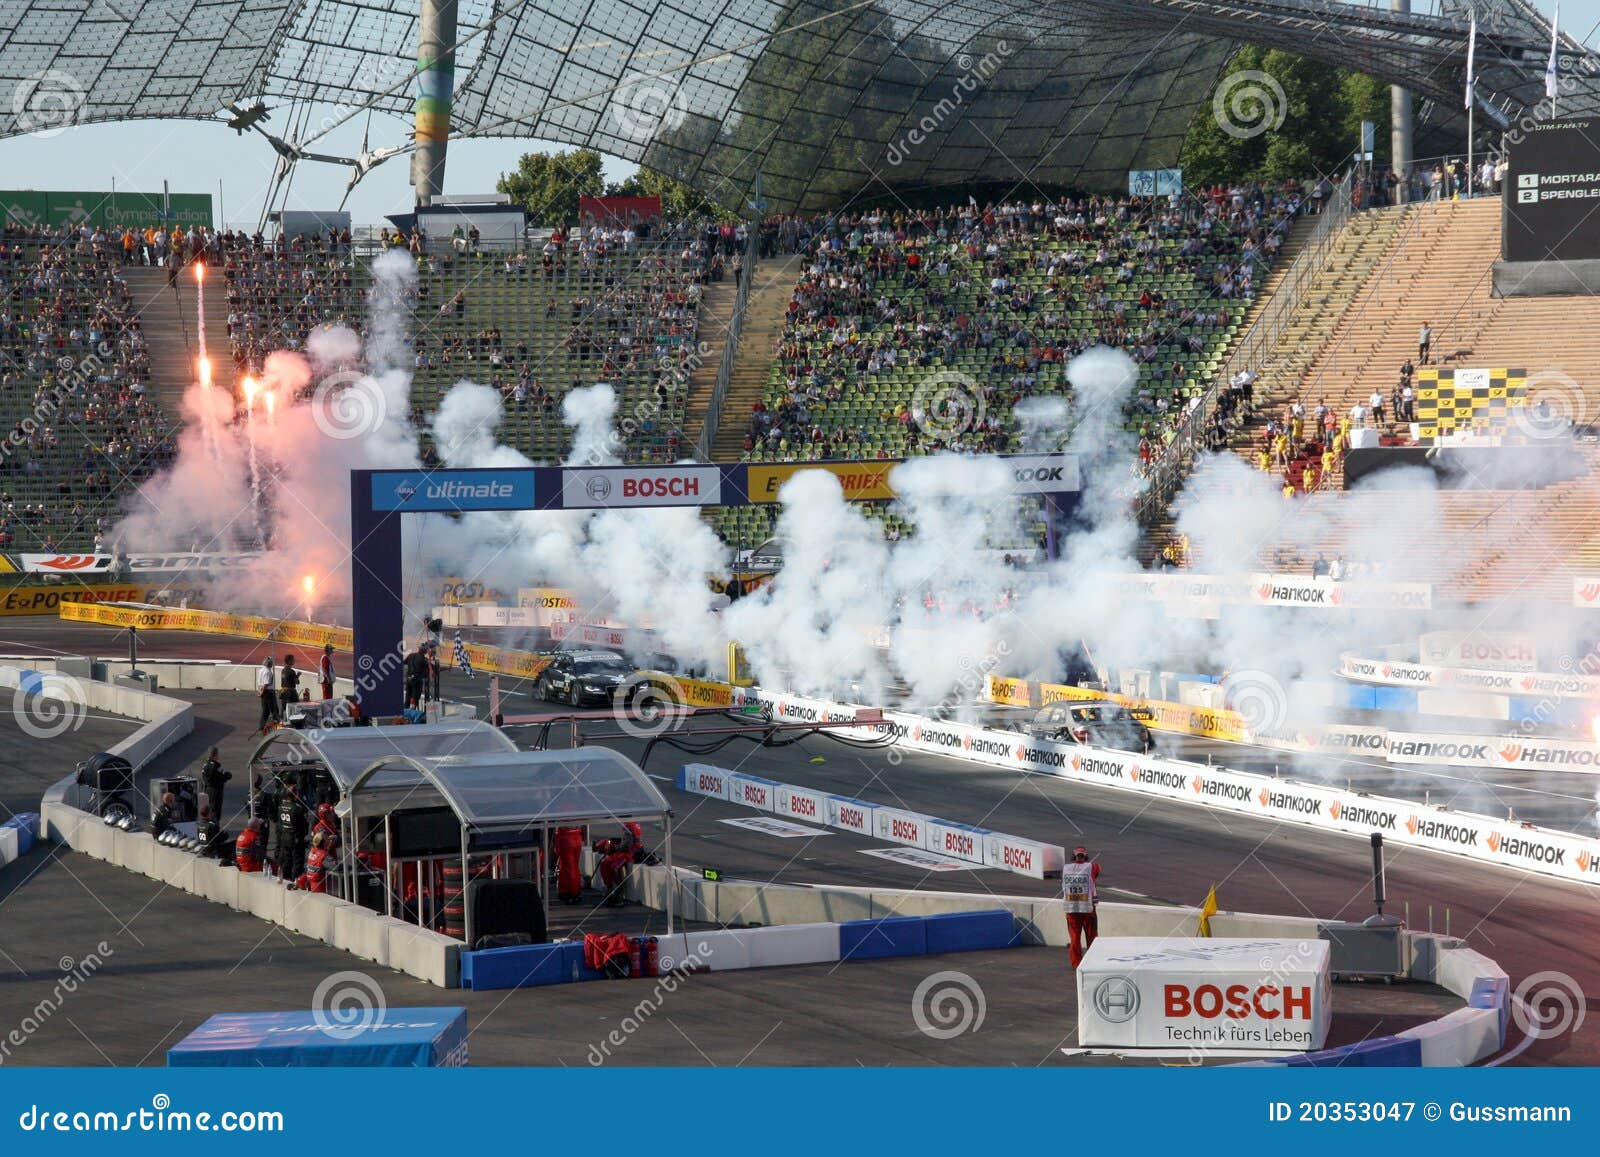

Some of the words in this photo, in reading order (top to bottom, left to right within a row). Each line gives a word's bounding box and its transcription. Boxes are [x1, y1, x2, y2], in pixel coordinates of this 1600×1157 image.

[1523, 191, 1533, 200] 2
[1540, 188, 1600, 200] SPENGLE
[426, 481, 514, 499] ultimate
[622, 477, 700, 498] BOSCH
[699, 774, 722, 794] BOSCH
[744, 785, 766, 806] BOSCH
[791, 795, 816, 817] BOSCH
[840, 806, 864, 829] BOSCH
[892, 819, 918, 842] BOSCH
[945, 831, 973, 856] BOSCH
[1003, 845, 1032, 871] BOSCH
[1164, 983, 1312, 1020] BOSCH
[1165, 1025, 1226, 1041] Technik
[1230, 1025, 1262, 1042] fürs
[1264, 1027, 1313, 1043] Leben
